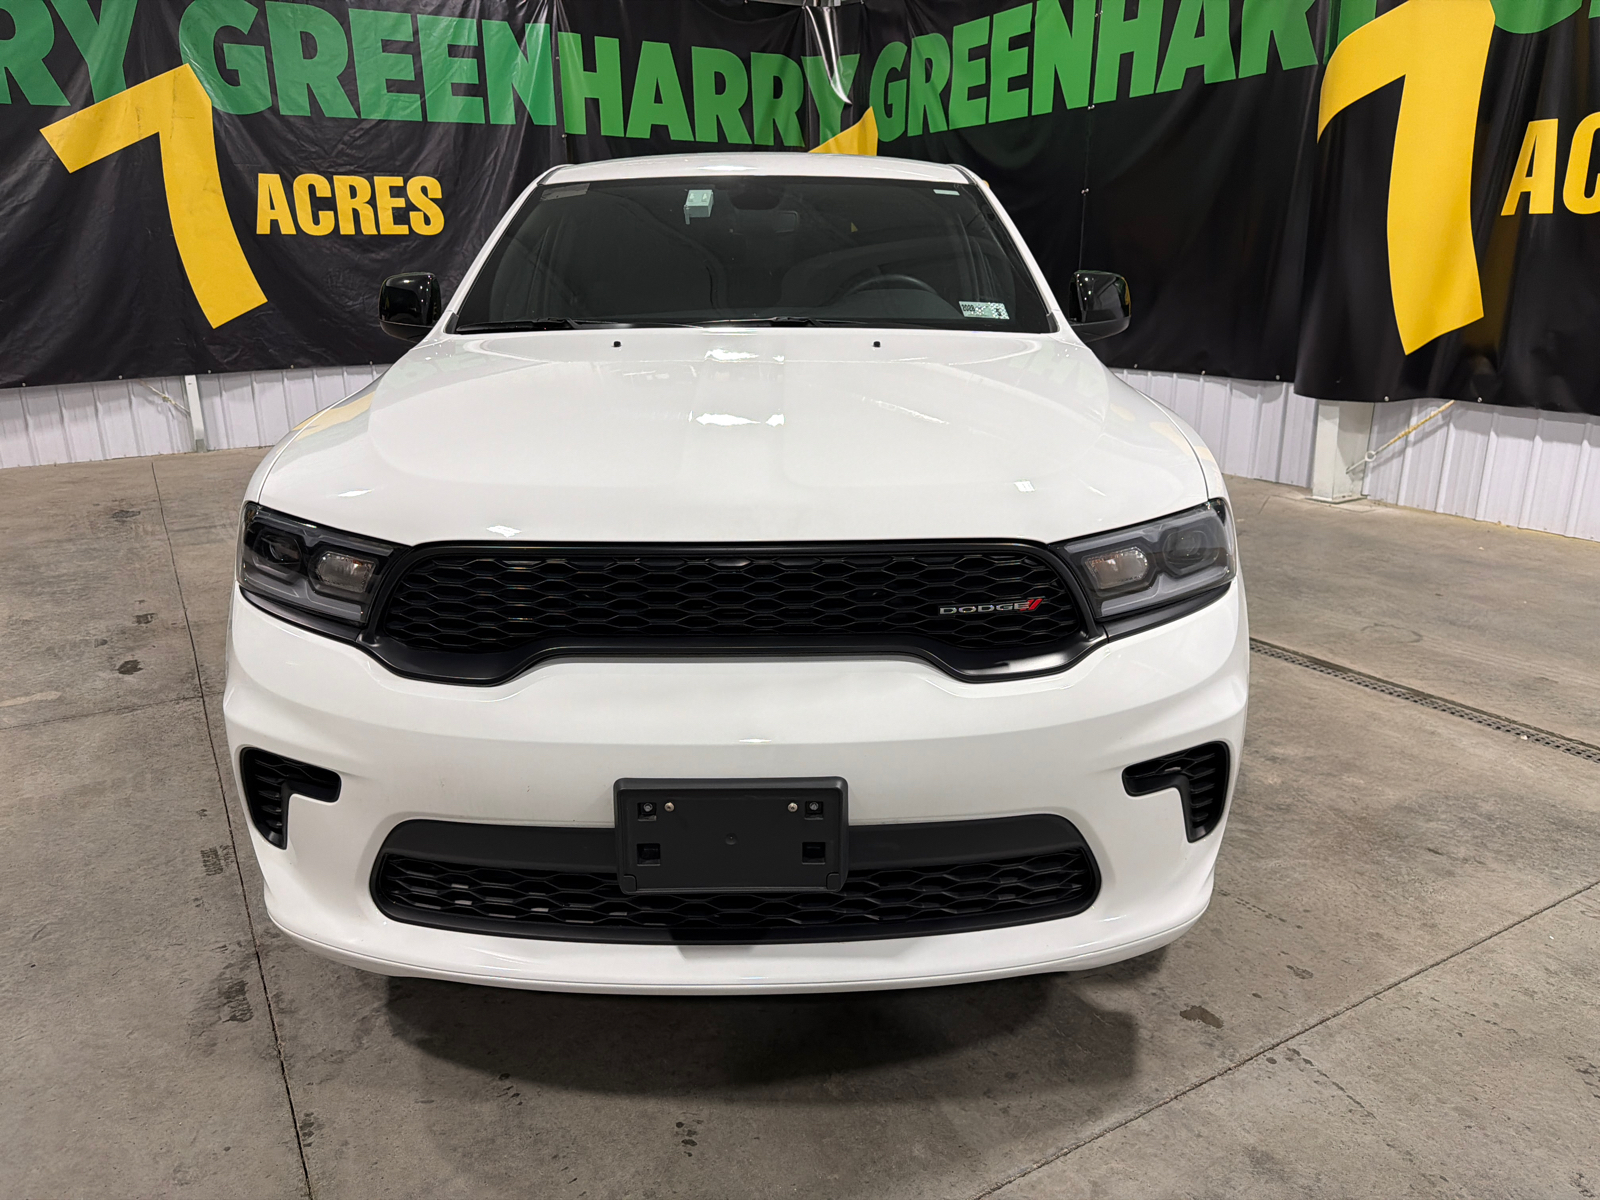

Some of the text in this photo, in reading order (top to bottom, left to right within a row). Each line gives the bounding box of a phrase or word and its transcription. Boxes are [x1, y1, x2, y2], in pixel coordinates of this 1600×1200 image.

[179, 0, 557, 126] GREEN
[557, 0, 1097, 148] HARRY GREEN
[256, 173, 445, 236] ACRES
[939, 602, 1030, 614] DODGE
